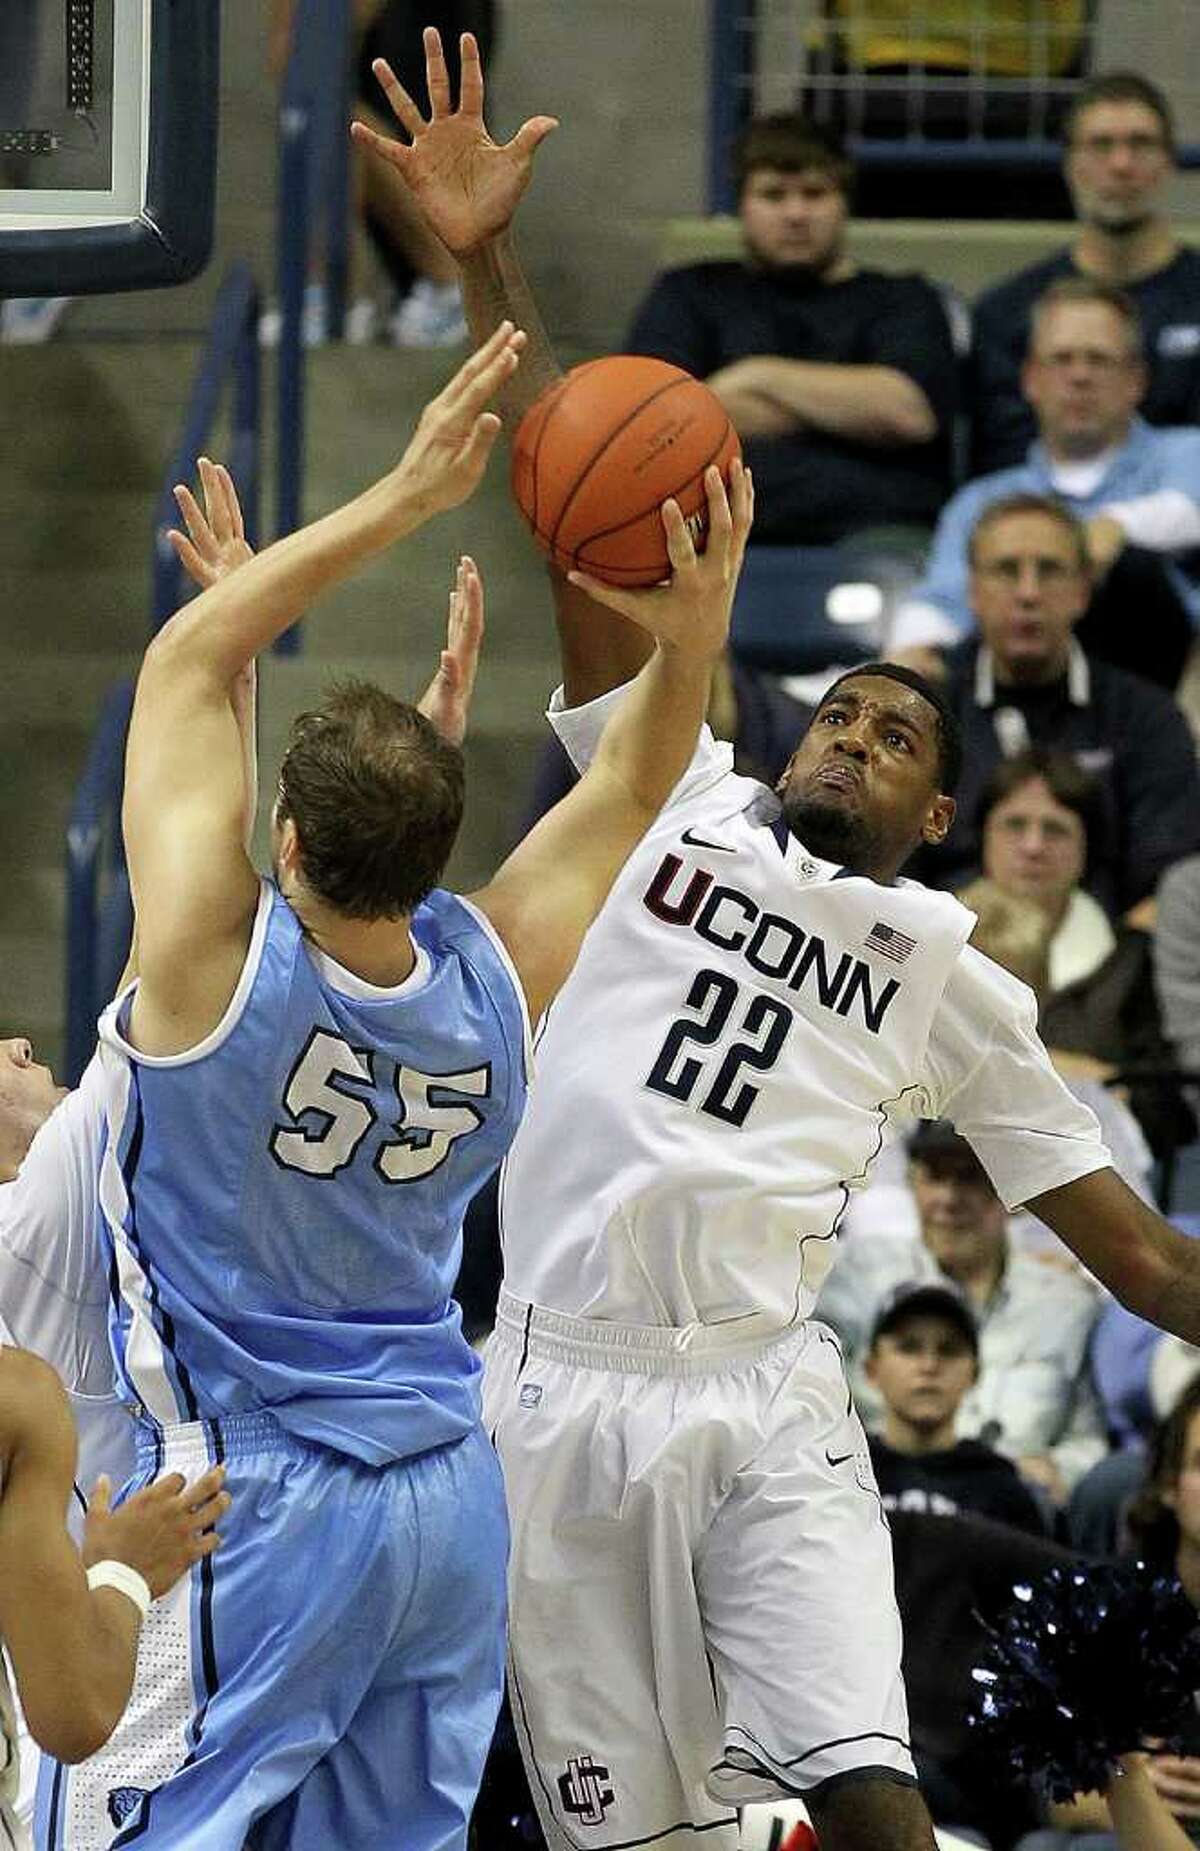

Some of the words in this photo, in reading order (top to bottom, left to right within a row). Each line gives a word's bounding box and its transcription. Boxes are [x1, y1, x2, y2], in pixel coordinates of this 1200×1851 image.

[643, 852, 901, 1034] UCONN
[268, 1024, 492, 1185] 55
[645, 967, 794, 1129] 22
